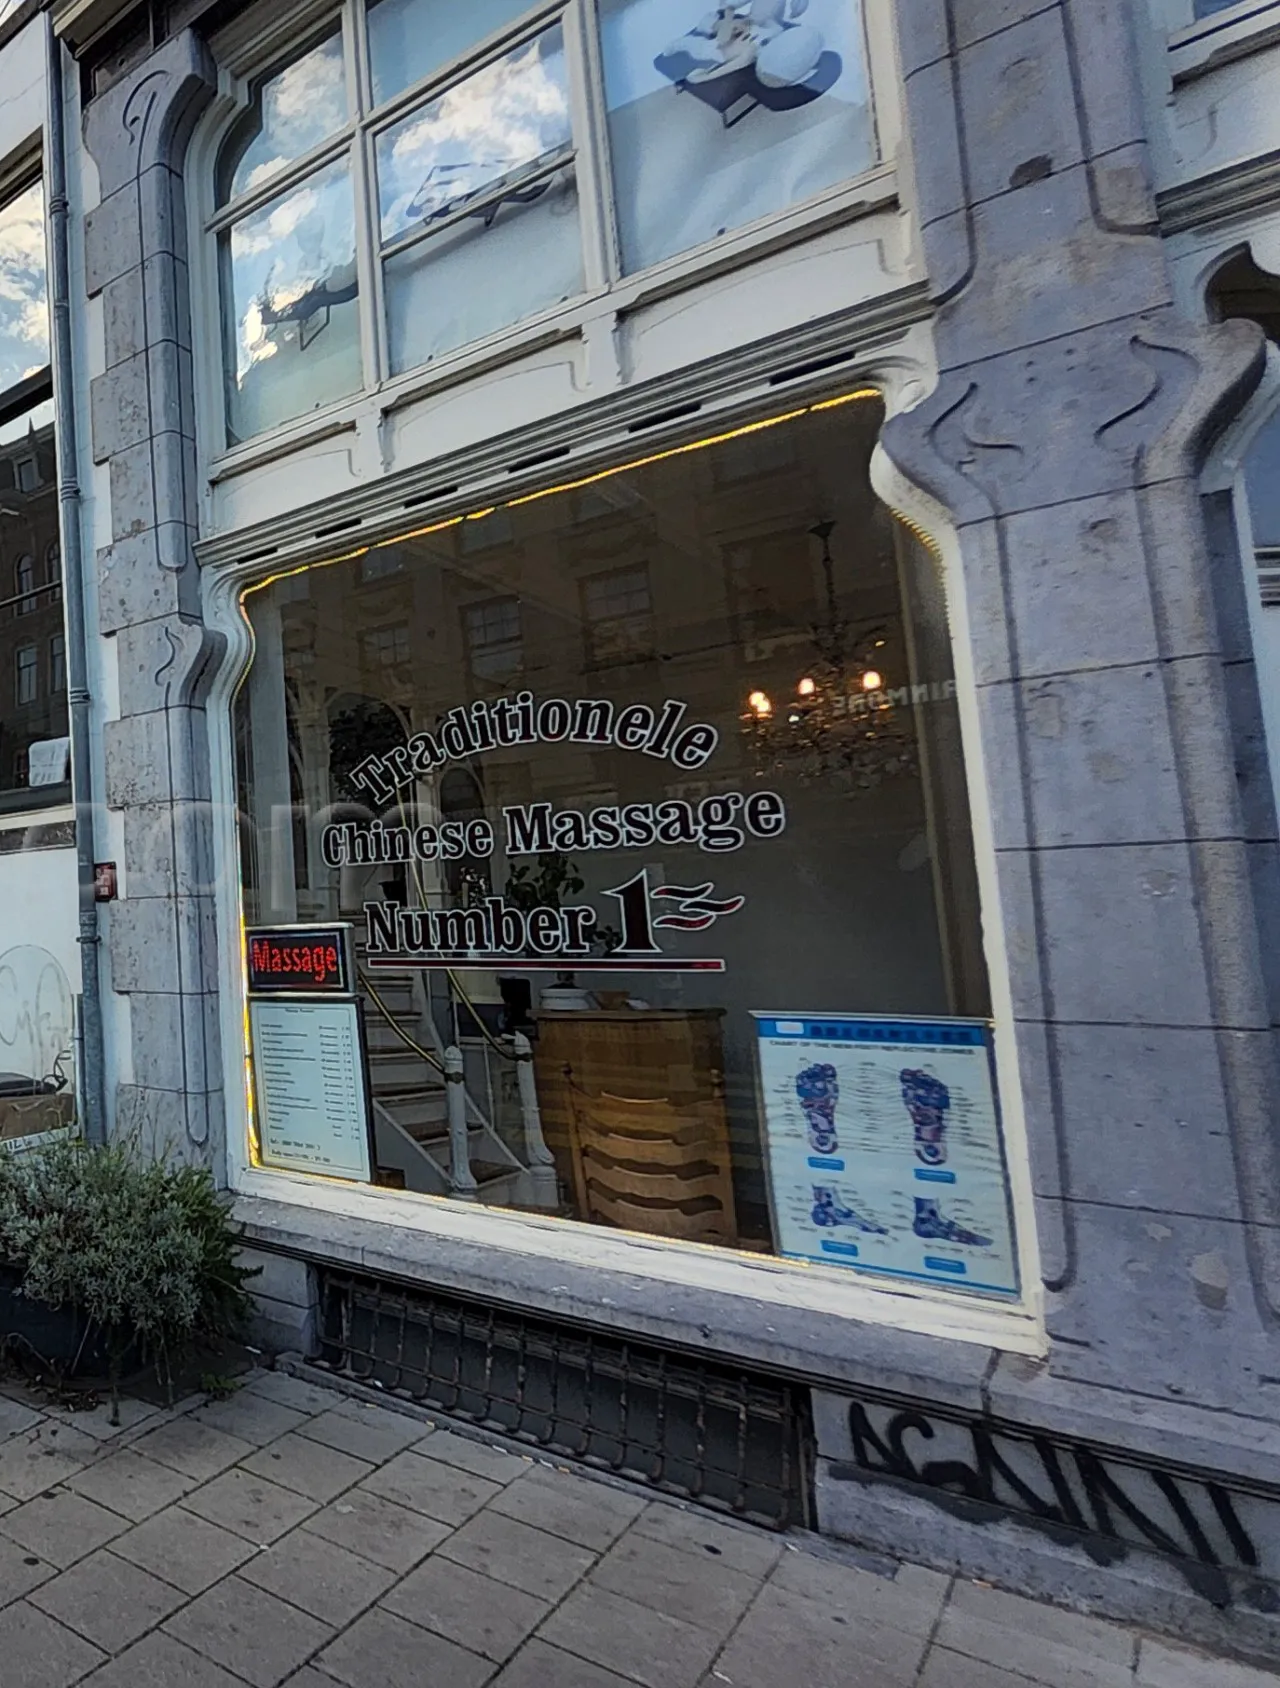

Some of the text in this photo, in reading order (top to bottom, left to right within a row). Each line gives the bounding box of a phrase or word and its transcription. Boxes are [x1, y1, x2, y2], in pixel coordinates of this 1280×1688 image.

[349, 691, 719, 806] Traditionele
[321, 790, 786, 868] Chinese Massage
[363, 868, 663, 953] Number 1
[252, 940, 338, 982] Massage
